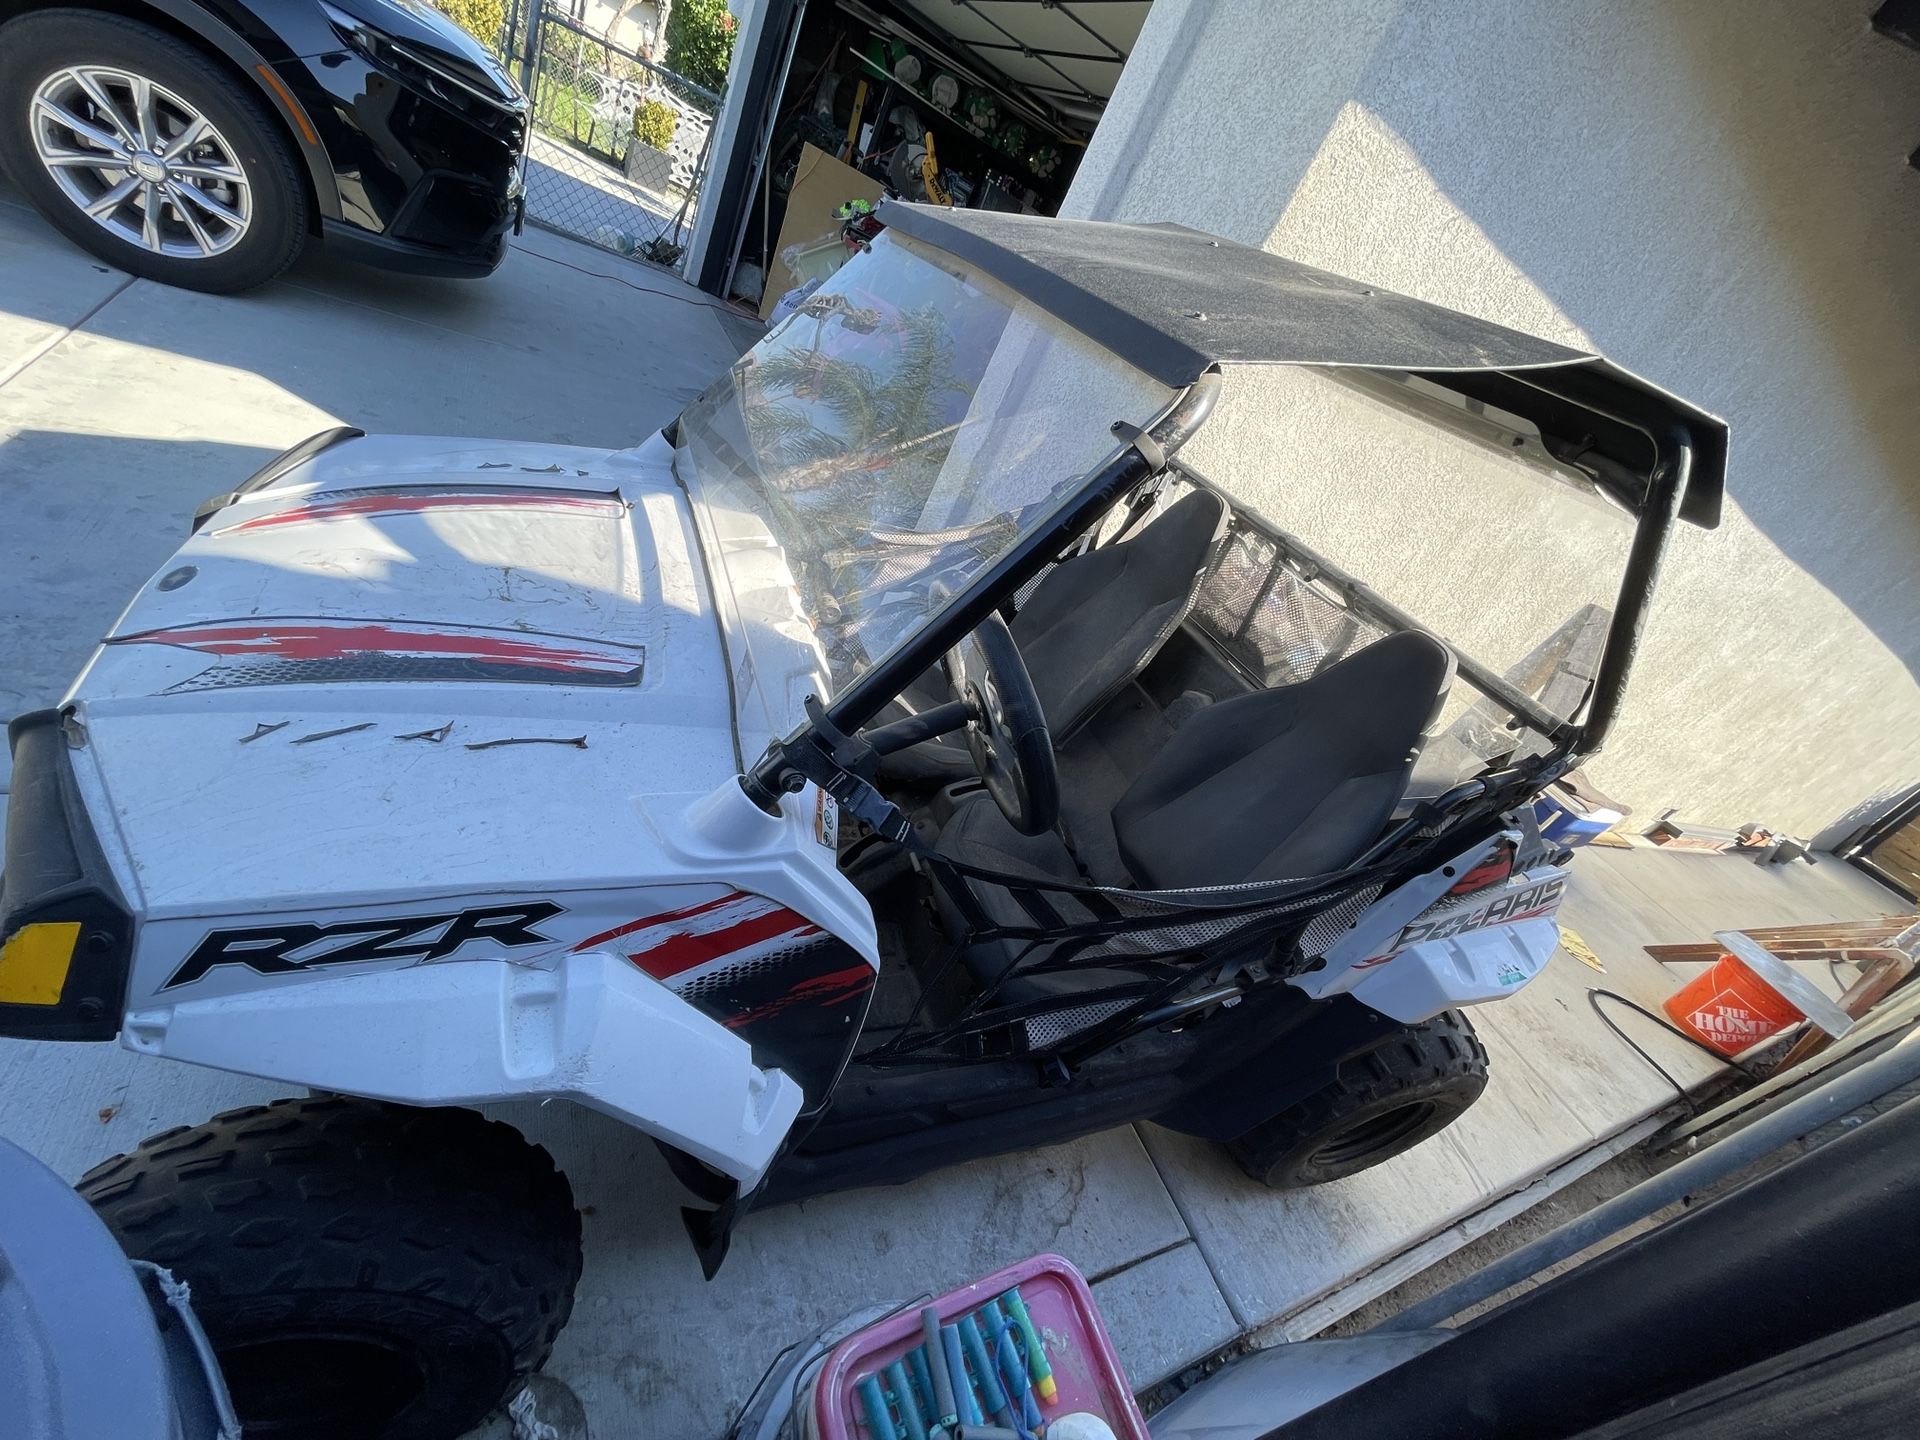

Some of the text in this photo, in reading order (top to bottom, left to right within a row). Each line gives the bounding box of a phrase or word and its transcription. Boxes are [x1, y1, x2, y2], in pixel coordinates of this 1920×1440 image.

[1388, 881, 1563, 953] POLARIS
[153, 900, 569, 995] RZR
[1695, 1012, 1774, 1034] HOME
[1716, 1005, 1750, 1020] THE
